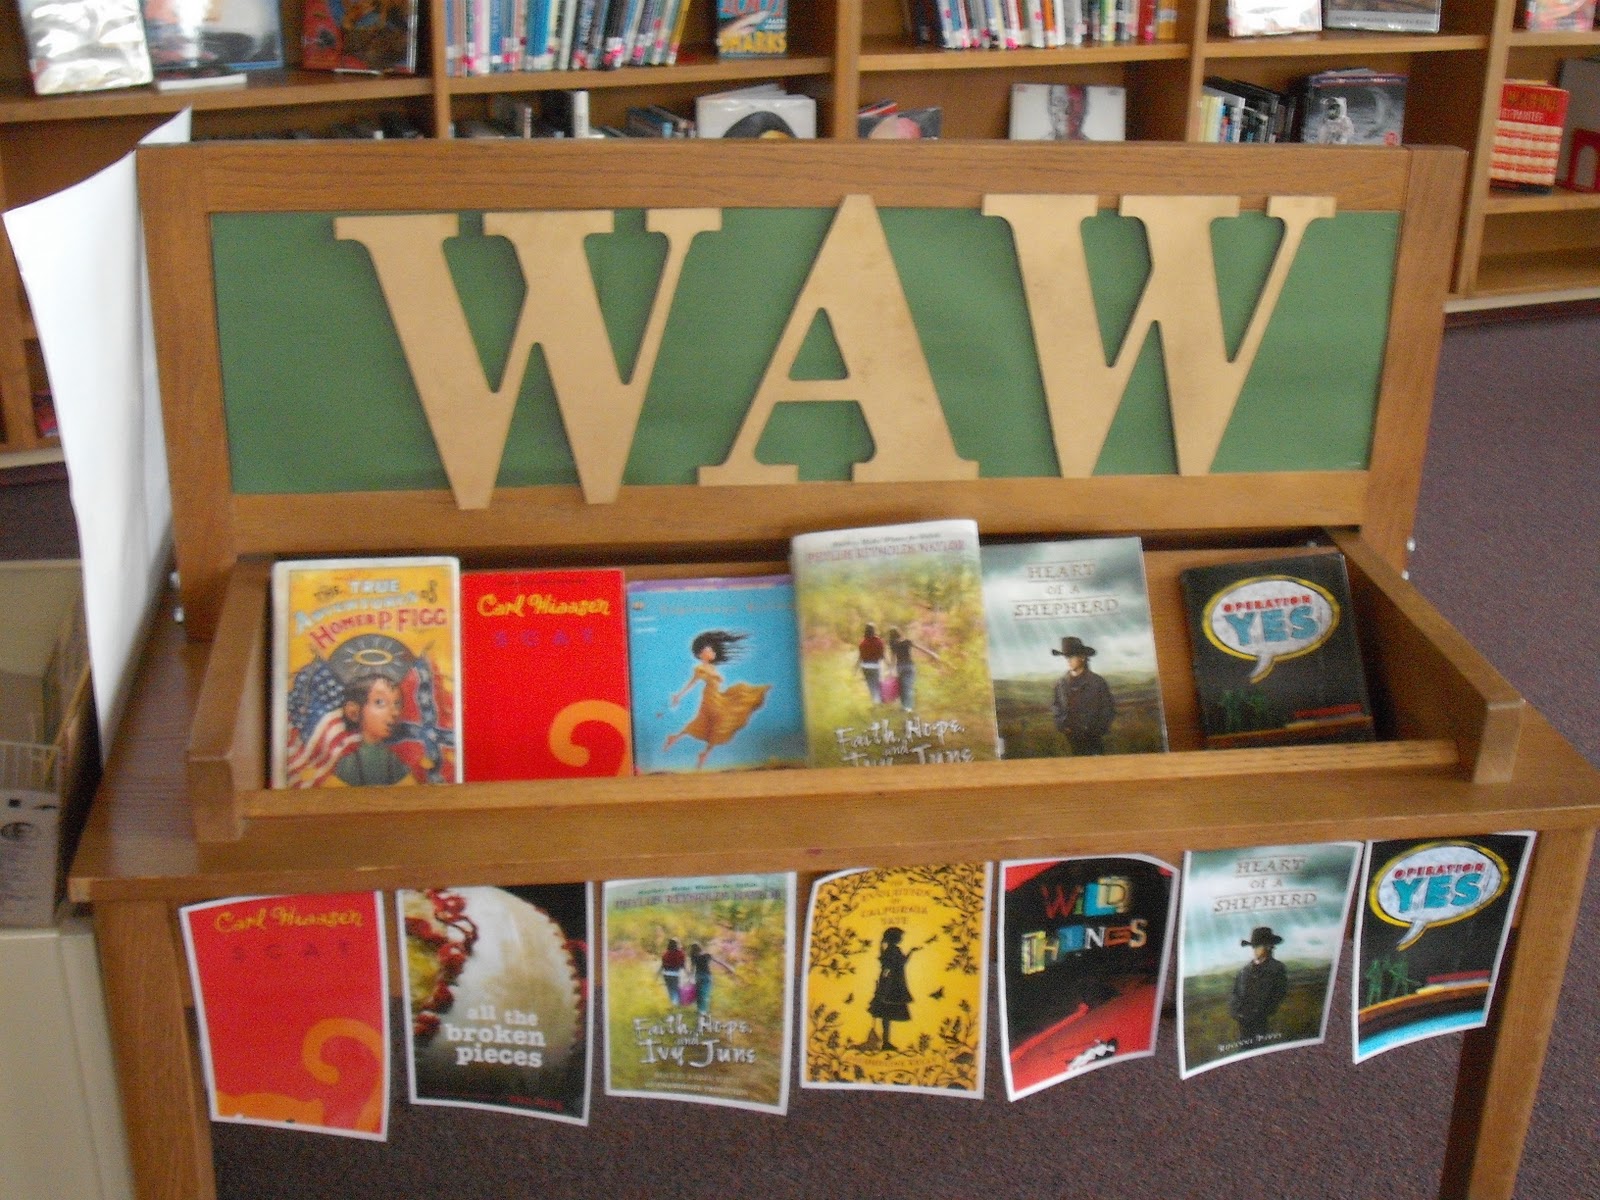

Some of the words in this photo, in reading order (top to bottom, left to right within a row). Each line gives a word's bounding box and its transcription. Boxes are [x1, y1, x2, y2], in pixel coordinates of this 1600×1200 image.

[334, 193, 1337, 511] WAW
[1027, 563, 1097, 580] HEART
[349, 579, 400, 594] TRUE
[476, 593, 526, 618] Carl
[1014, 598, 1120, 617] SHEPHERD
[1222, 594, 1313, 614] OPERATION
[309, 611, 376, 650] HOMER
[397, 607, 447, 633] FIGG
[1223, 604, 1320, 647] YES
[1235, 858, 1306, 875] HEART
[1393, 862, 1486, 880] OPERATION
[1213, 892, 1318, 913] SHEPHERD
[1391, 872, 1483, 914] YES
[214, 907, 268, 933] Carl
[1022, 918, 1148, 975] THINGS
[466, 1005, 497, 1021] all
[504, 1008, 539, 1027] the
[445, 1022, 547, 1048] broken
[455, 1043, 543, 1068] pieces
[637, 1038, 685, 1067] Ivy
[689, 1038, 757, 1068] June
